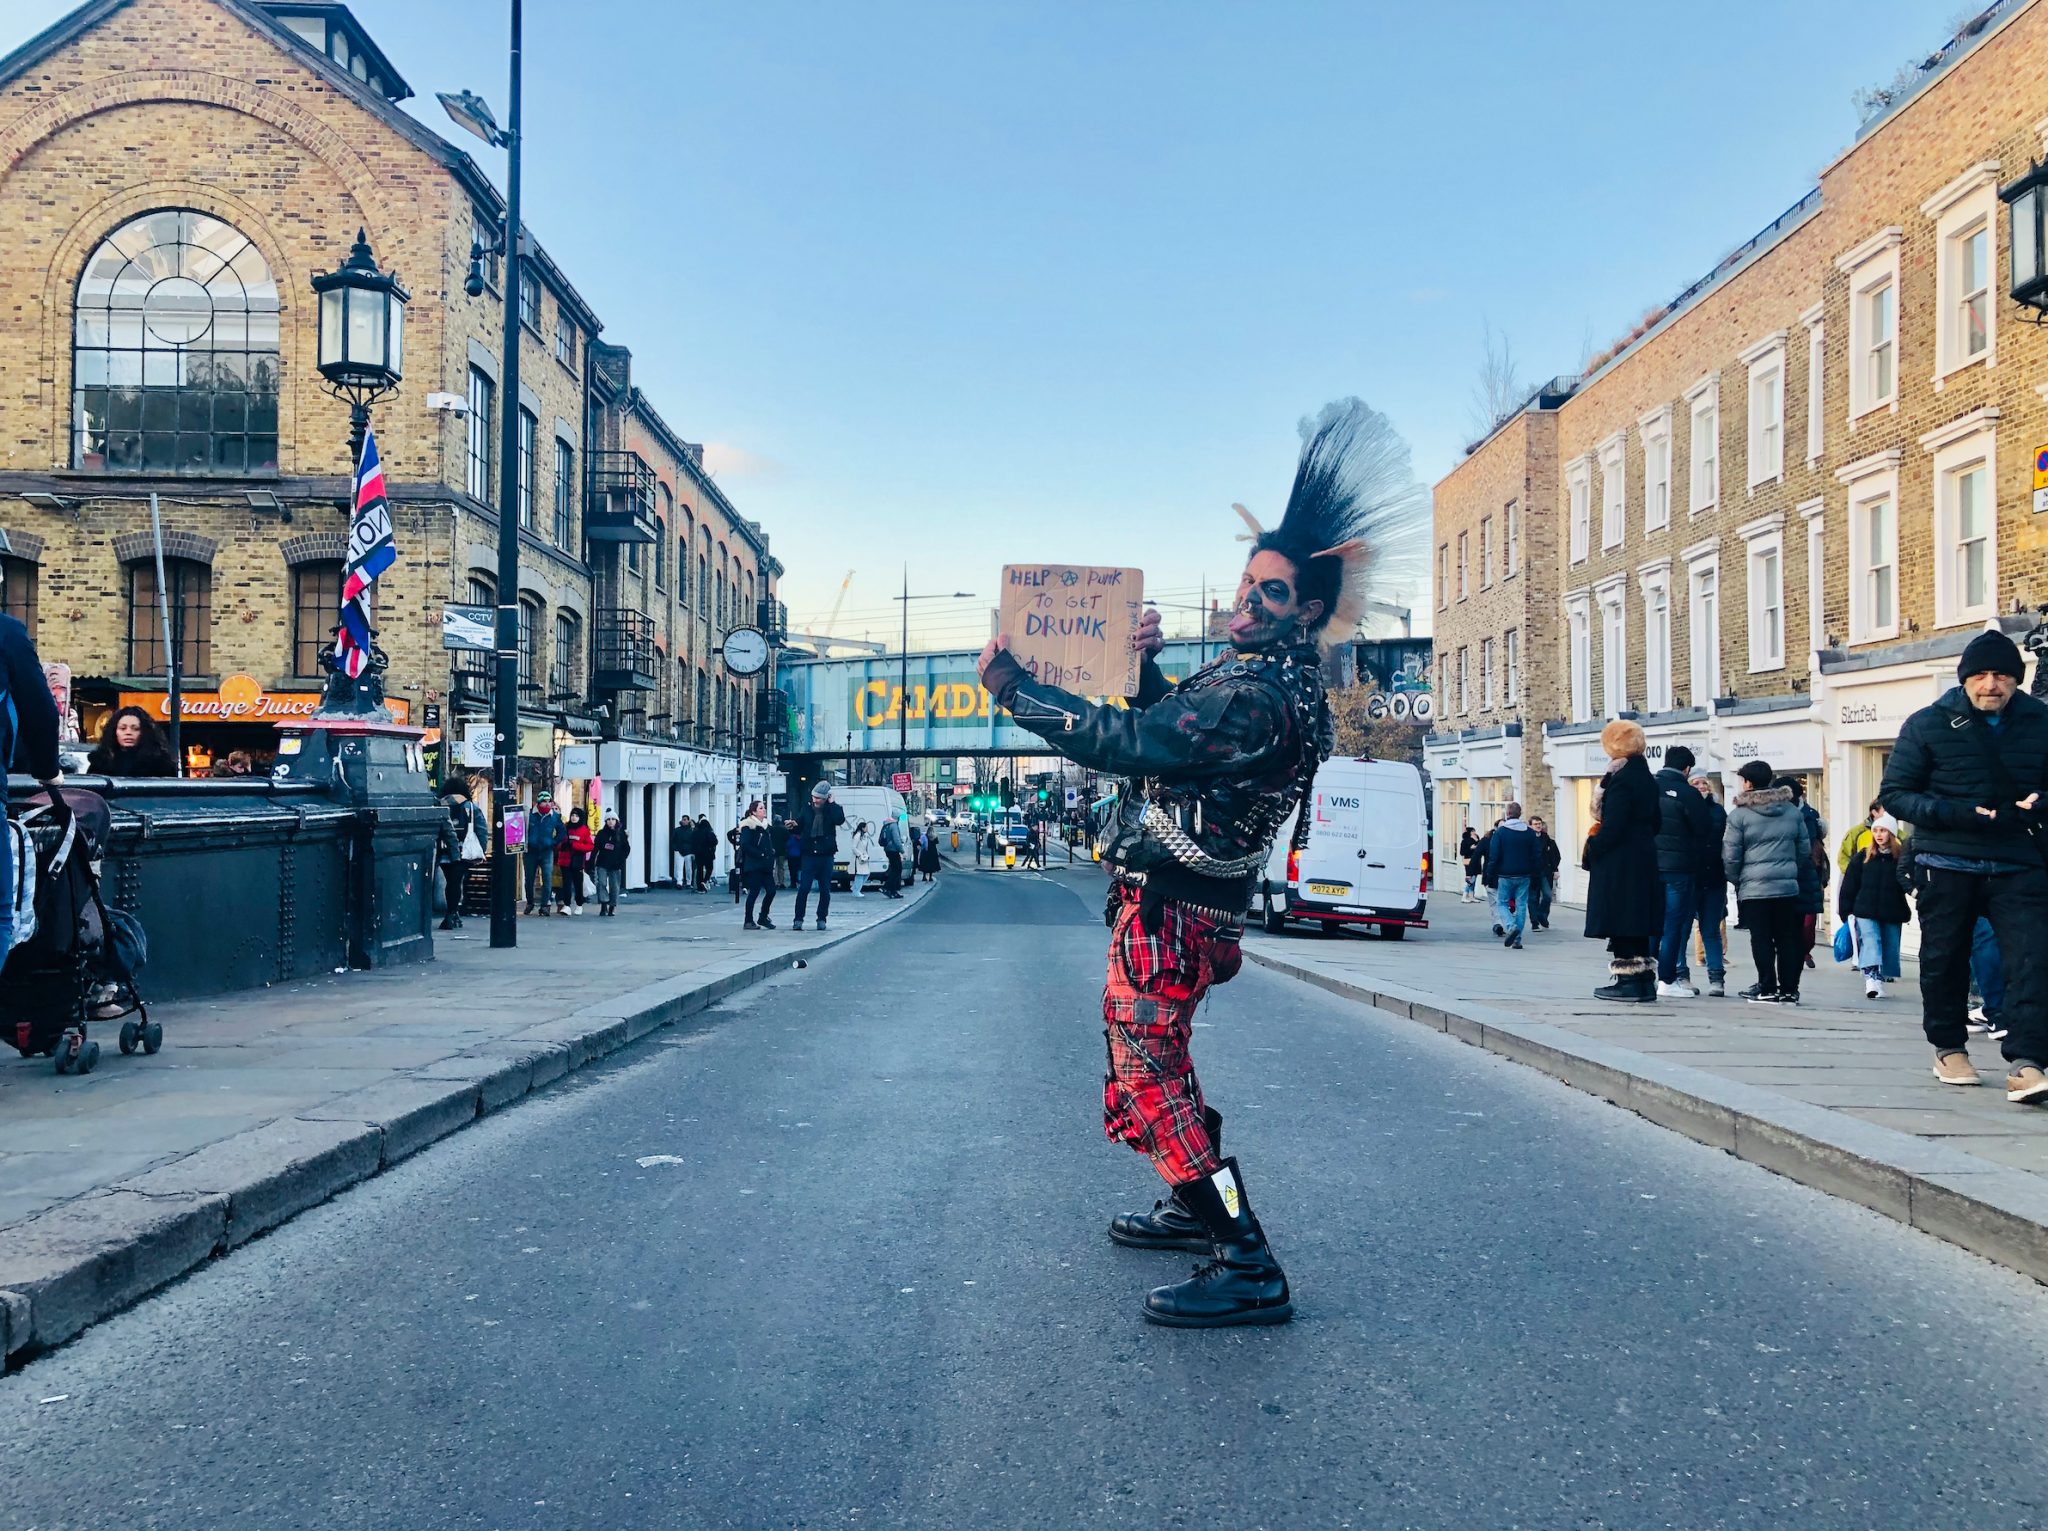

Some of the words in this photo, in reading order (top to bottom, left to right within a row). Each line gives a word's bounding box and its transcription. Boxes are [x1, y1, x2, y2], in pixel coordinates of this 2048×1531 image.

[1010, 569, 1050, 587] HELP
[1034, 593, 1053, 609] TO
[1065, 594, 1102, 609] GET
[468, 612, 493, 622] CCTV
[1025, 611, 1107, 642] DRUNK
[1044, 661, 1092, 686] PHOTO
[160, 696, 249, 720] Orange
[254, 697, 316, 717] Juice
[855, 679, 1012, 727] CAMDE
[1330, 796, 1360, 808] VMS
